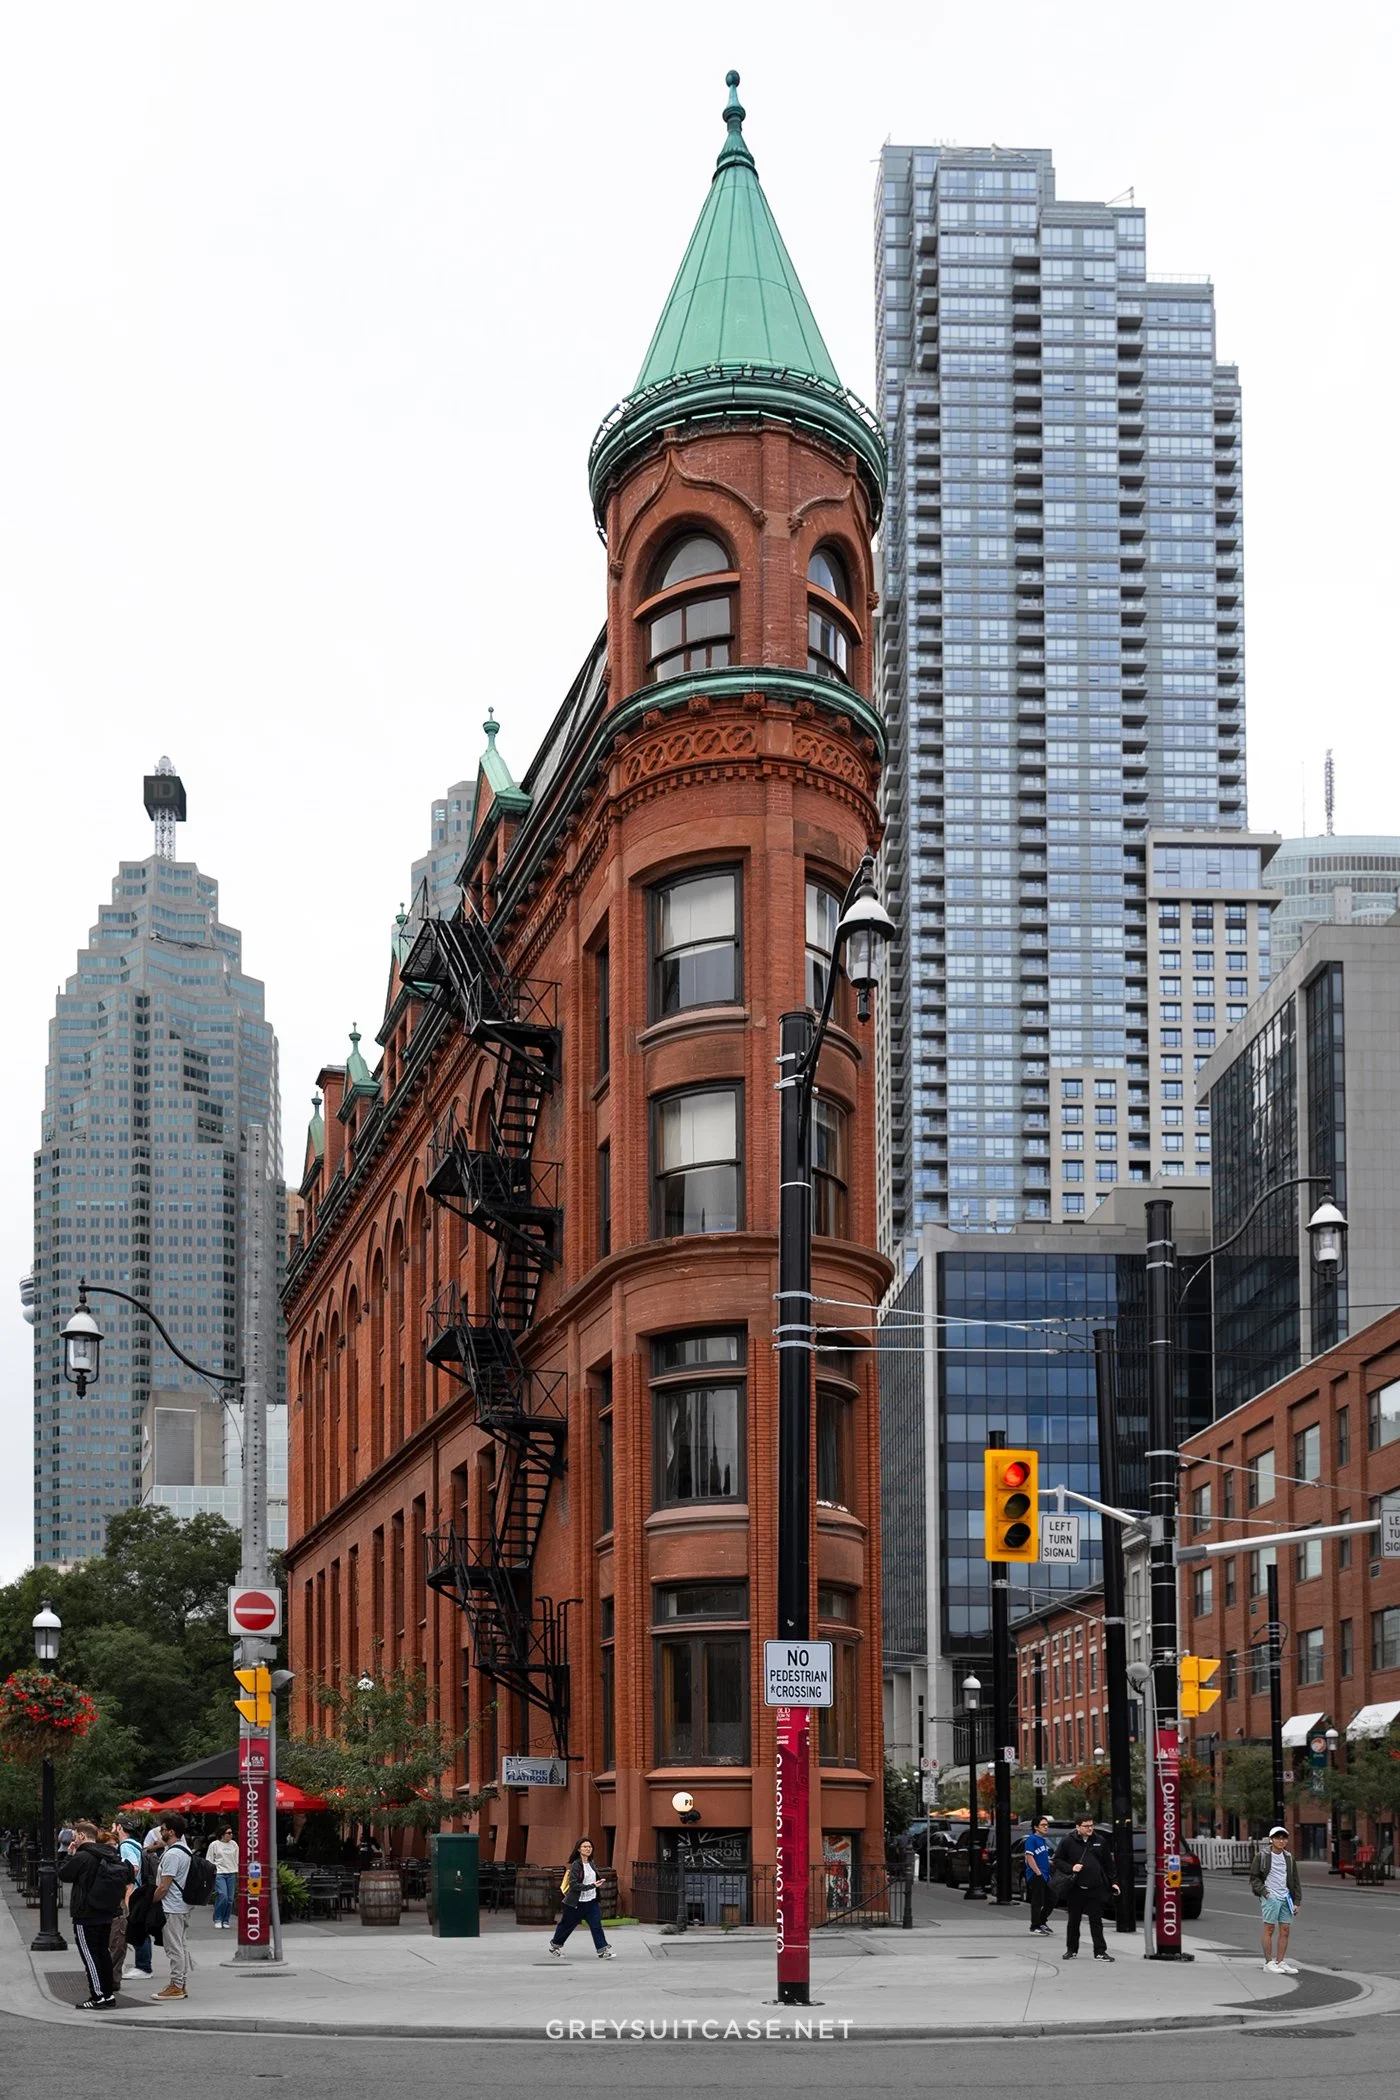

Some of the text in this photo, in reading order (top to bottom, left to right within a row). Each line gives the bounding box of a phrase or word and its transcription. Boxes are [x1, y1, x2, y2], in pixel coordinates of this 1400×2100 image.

[1049, 1521, 1072, 1531] LEFT
[1048, 1534, 1073, 1545] TURN
[1044, 1547, 1076, 1558] SIGNAL
[787, 1649, 810, 1667] NO
[769, 1669, 828, 1683] PEDESTRIAN
[775, 1685, 822, 1698] CROSSING
[1034, 1776, 1046, 1785] 40
[1163, 1782, 1176, 1850] TORONTO
[246, 1790, 259, 1857] TORONTO
[718, 1839, 742, 1848] THE
[247, 1906, 261, 1941] OLD
[1164, 1901, 1177, 1936] OLD
